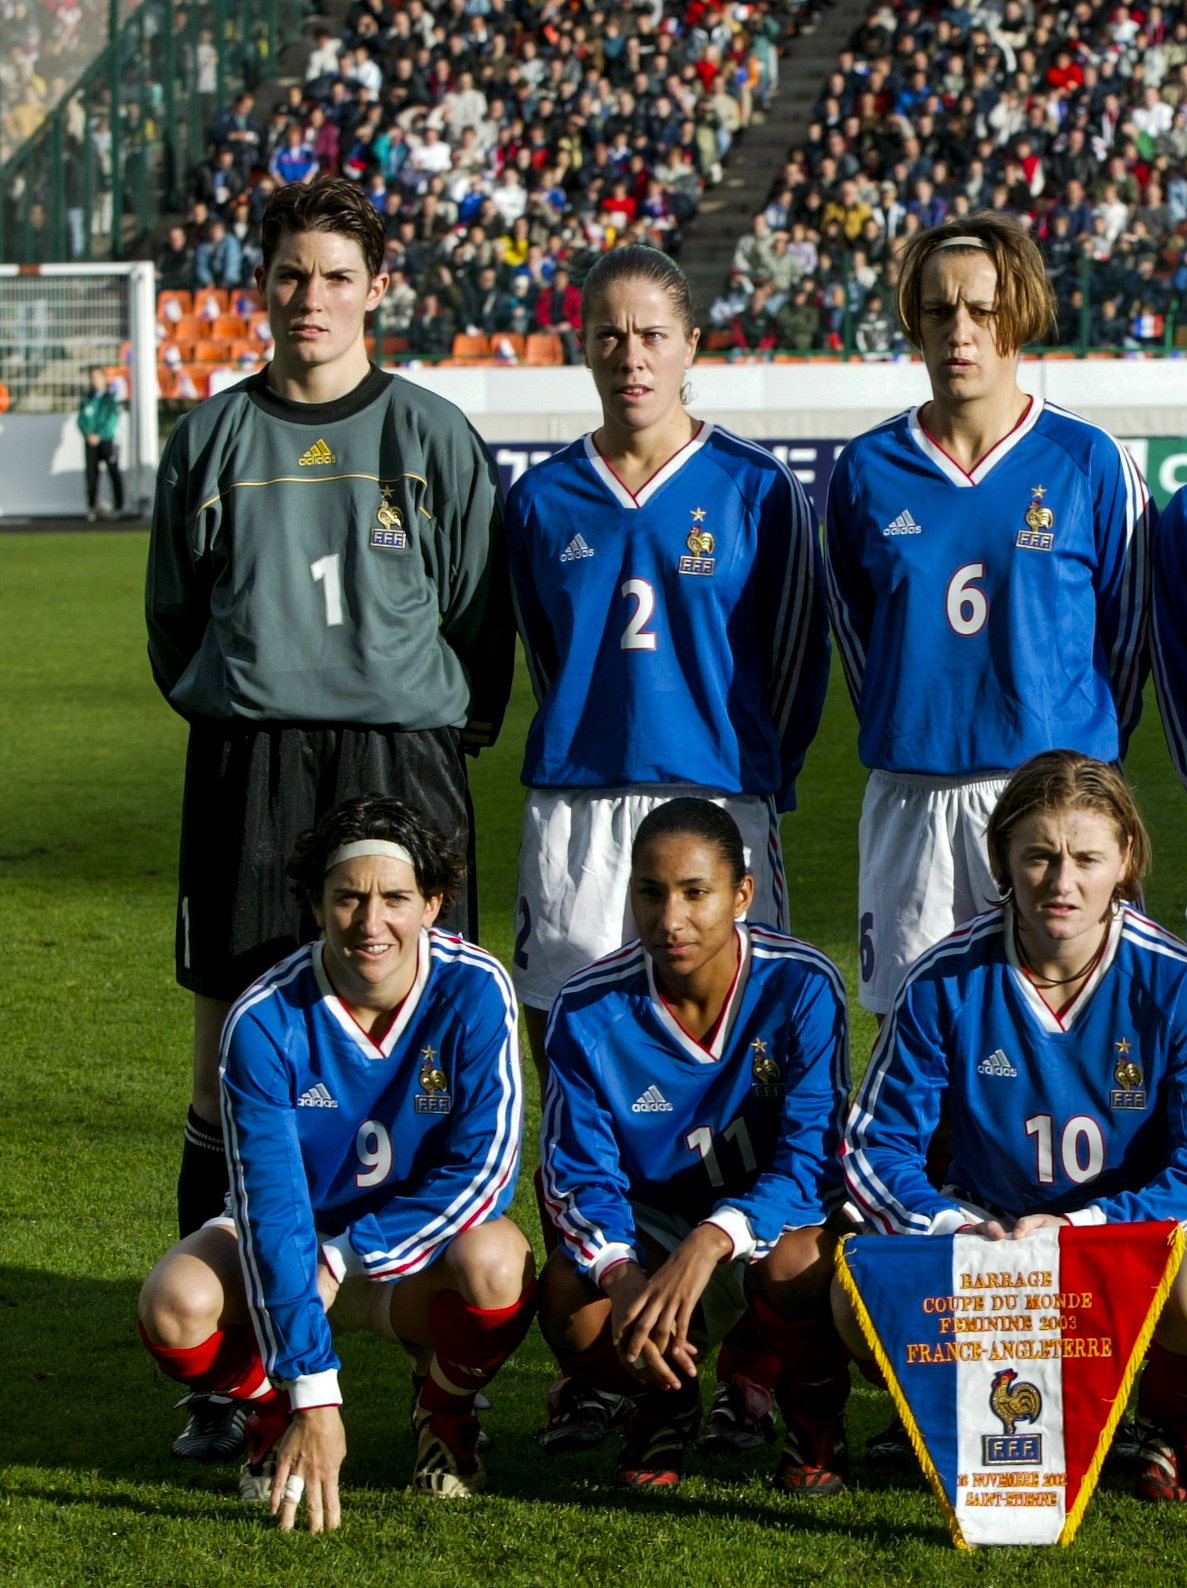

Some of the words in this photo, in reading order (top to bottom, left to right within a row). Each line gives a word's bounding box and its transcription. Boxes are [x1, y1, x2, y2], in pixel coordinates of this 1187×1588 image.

[883, 526, 922, 536] adidas
[560, 548, 595, 562] adidas
[310, 553, 344, 627] 1
[945, 551, 989, 636] 6
[619, 578, 658, 651] 2
[860, 911, 876, 984] 6
[977, 1065, 1018, 1078] adidas
[298, 1097, 339, 1108] adidas
[632, 1102, 674, 1113] adidas
[355, 1119, 393, 1188] 9
[685, 1116, 758, 1188] 11
[1025, 1114, 1104, 1184] 10
[960, 1271, 1053, 1289] BARRAGE
[922, 1295, 985, 1313] COUPE
[991, 1294, 1018, 1311] DU
[1024, 1292, 1093, 1310] MONDE
[938, 1315, 1033, 1334] FEMININE
[1039, 1315, 1078, 1331] 2003
[906, 1337, 1113, 1364] FRANCE-ANGLETERRE
[972, 1471, 1040, 1488] NOVEMBRE
